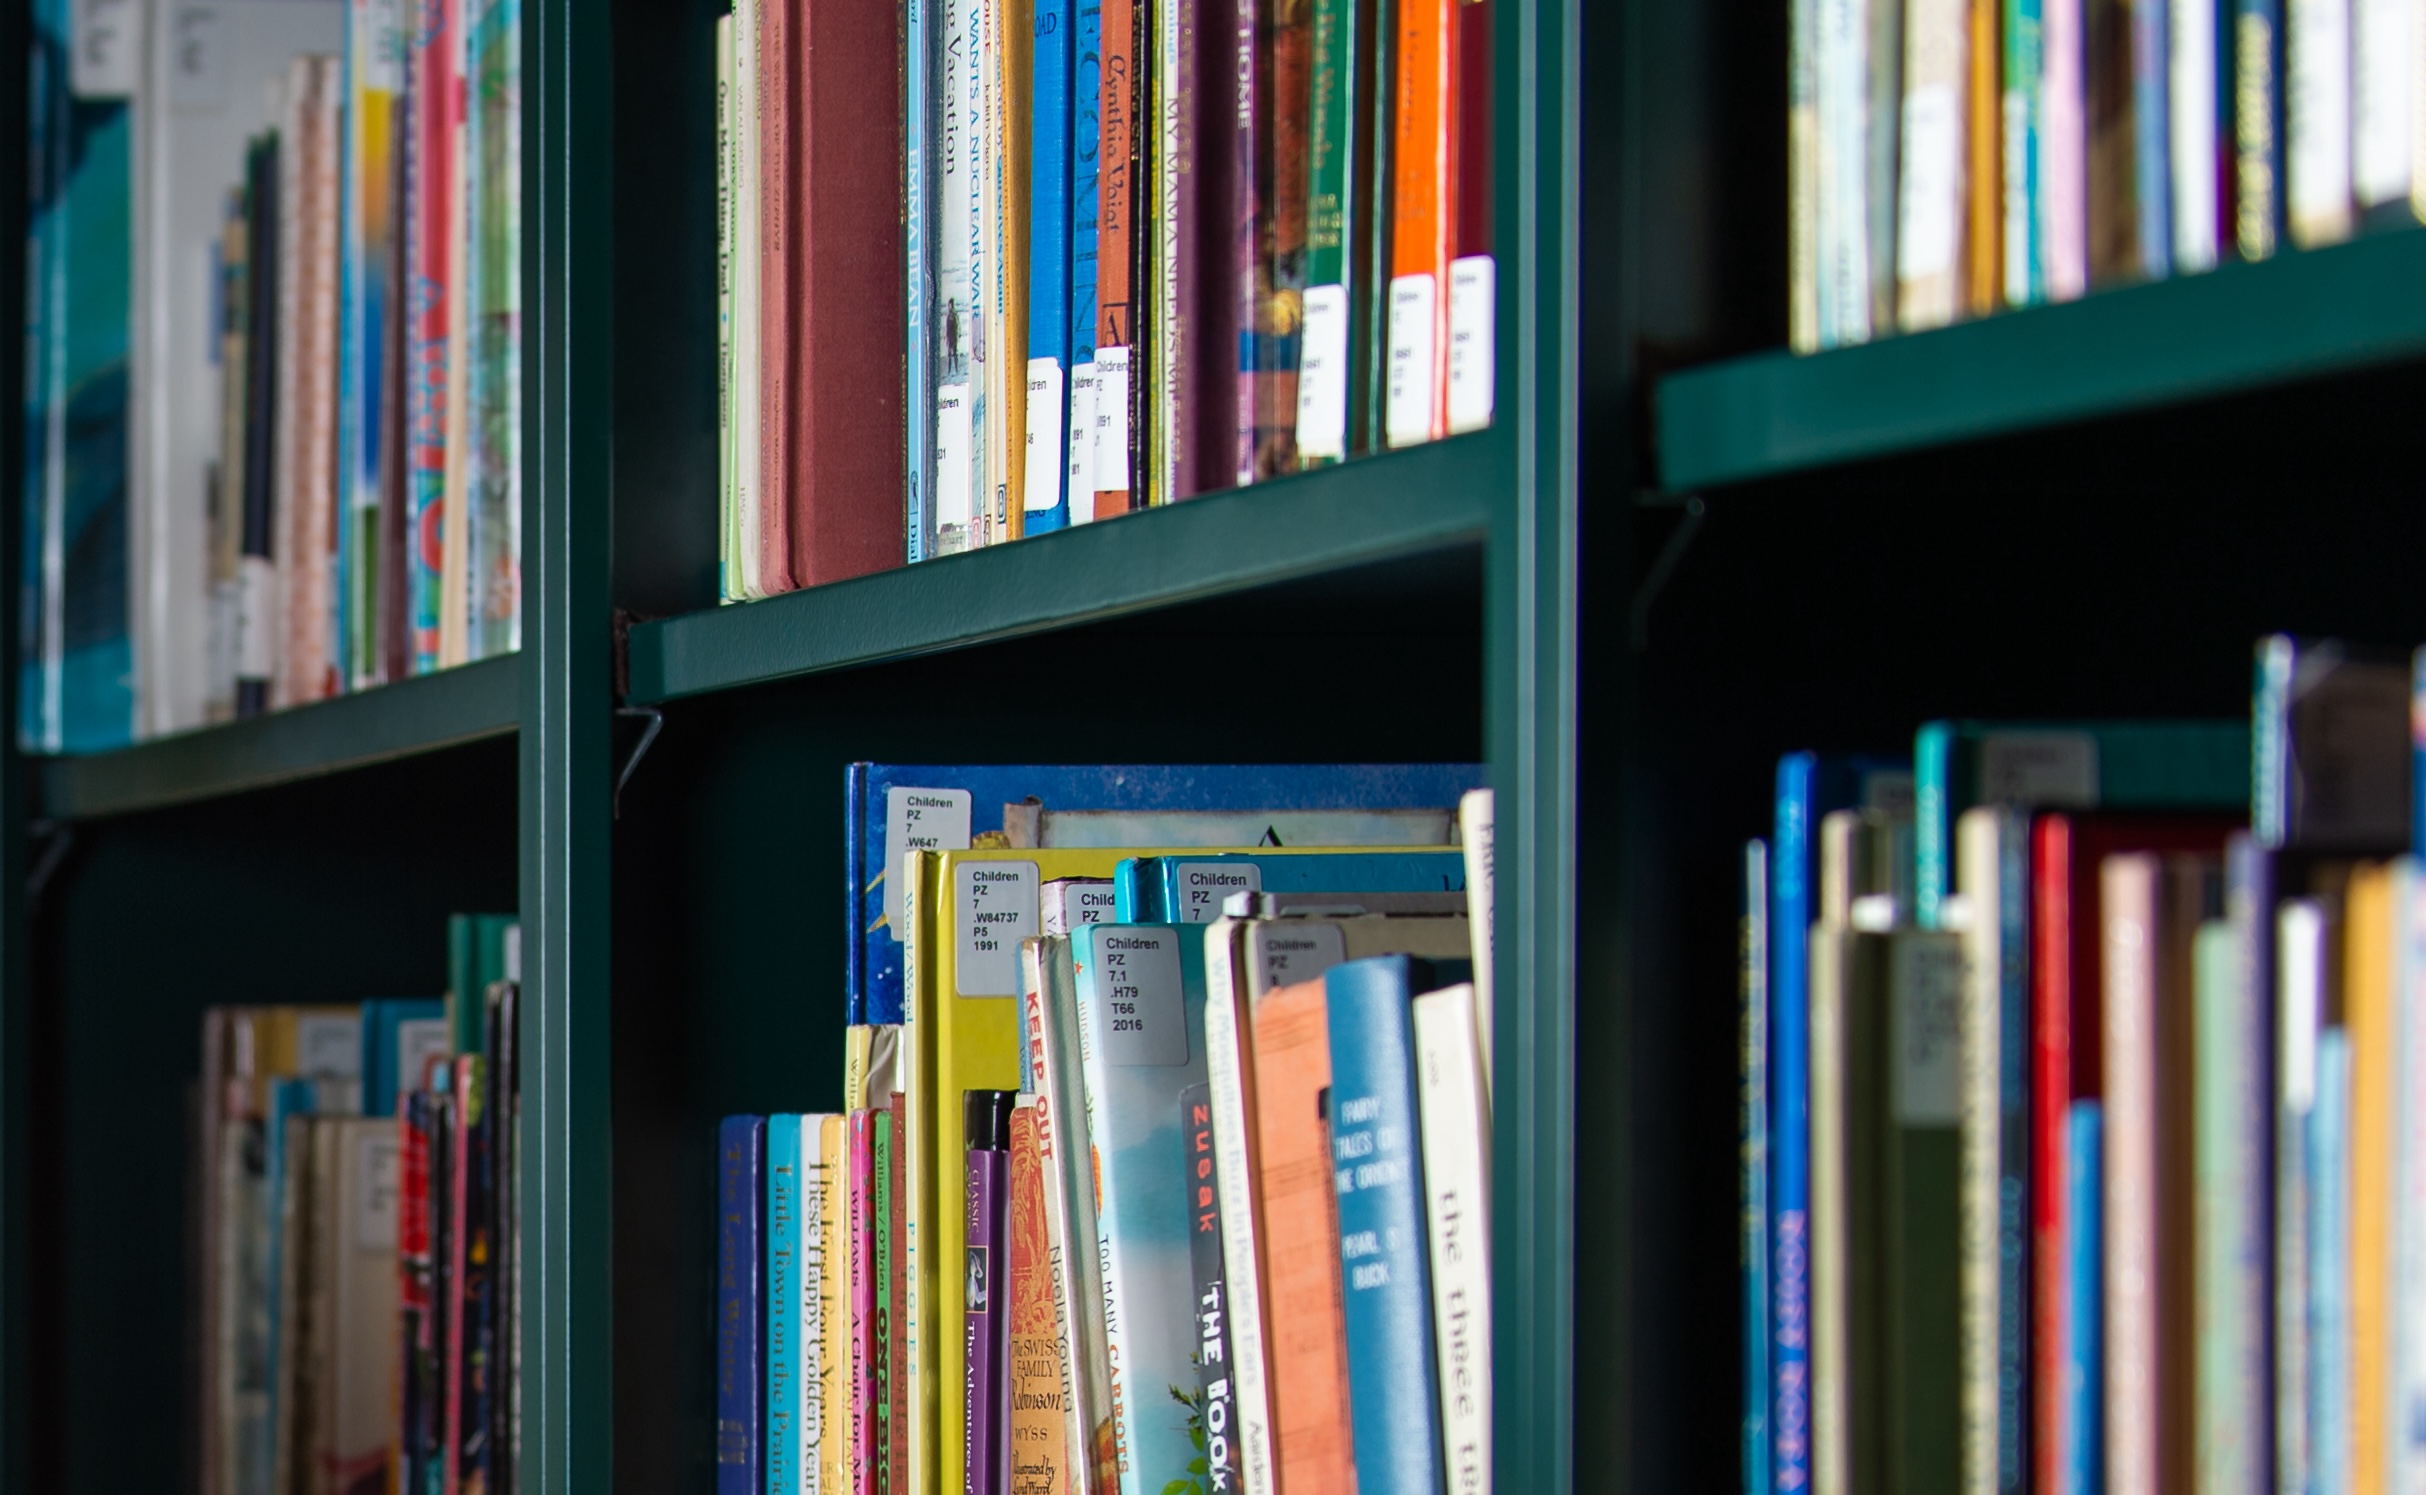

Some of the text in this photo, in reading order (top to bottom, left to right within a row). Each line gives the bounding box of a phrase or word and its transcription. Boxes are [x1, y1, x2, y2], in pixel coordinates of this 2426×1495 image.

[946, 34, 962, 176] Vacation
[1105, 54, 1126, 160] Cynthia
[1166, 97, 1178, 140] MY
[970, 8, 981, 322] WANTS A NUCLEAR WAR
[1166, 151, 1178, 247] MAMA
[908, 148, 919, 328] EMMA BEAN
[906, 810, 921, 820] PZ
[907, 796, 953, 808] Children
[905, 837, 938, 848] .W647
[906, 823, 912, 833] 7
[973, 870, 1019, 883] Children
[973, 885, 988, 896] PZ
[1190, 872, 1248, 887] Children
[1191, 890, 1211, 903] PZ
[905, 892, 914, 950] Wood
[973, 899, 979, 909] 7
[973, 912, 1019, 923] .W84737
[1080, 893, 1115, 907] Child
[1082, 910, 1100, 923] PZ
[1193, 909, 1200, 921] 7
[973, 926, 988, 937] P5
[974, 940, 999, 951] 1991
[1106, 937, 1160, 950] Children
[1266, 938, 1317, 951] Children
[1107, 954, 1126, 966] PZ
[1109, 970, 1127, 982] 7.1
[1268, 956, 1289, 969] PZ
[905, 964, 914, 1022] Wood
[1110, 986, 1139, 998] .H79
[1112, 1003, 1135, 1014] T66
[1078, 1001, 1092, 1062] HUDSON
[1113, 1019, 1143, 1031] 2016
[850, 1058, 859, 1109] Willia
[1026, 991, 1053, 1161] KEEP OUT
[876, 1142, 886, 1213] Williams
[774, 1163, 794, 1236] Little
[808, 1161, 822, 1237] These
[972, 1169, 980, 1233] CLASSIC
[851, 1190, 859, 1287] WILLIAMS
[1439, 1188, 1464, 1264] the
[820, 1217, 837, 1284] First
[877, 1228, 887, 1293] O'Brien
[774, 1241, 793, 1317] Town
[804, 1244, 822, 1333] Happy
[908, 1221, 917, 1377] PIGGIES
[1049, 1245, 1067, 1324] Noela
[773, 1322, 785, 1354] on
[820, 1292, 836, 1359] Four
[852, 1311, 861, 1329] A
[1017, 1360, 1056, 1378] FAMILY
[1024, 1338, 1060, 1358] SWISS
[1098, 1233, 1129, 1474] TOO MANY CARROTS
[773, 1361, 792, 1403] the
[806, 1338, 822, 1433] Golden
[852, 1337, 861, 1406] Chair
[1201, 1286, 1231, 1493] THE BOOK
[819, 1364, 836, 1439] Years
[965, 1320, 976, 1494] The Adventures of
[1011, 1375, 1061, 1412] Robinson
[852, 1414, 862, 1450] for
[1015, 1425, 1048, 1441] WYSS
